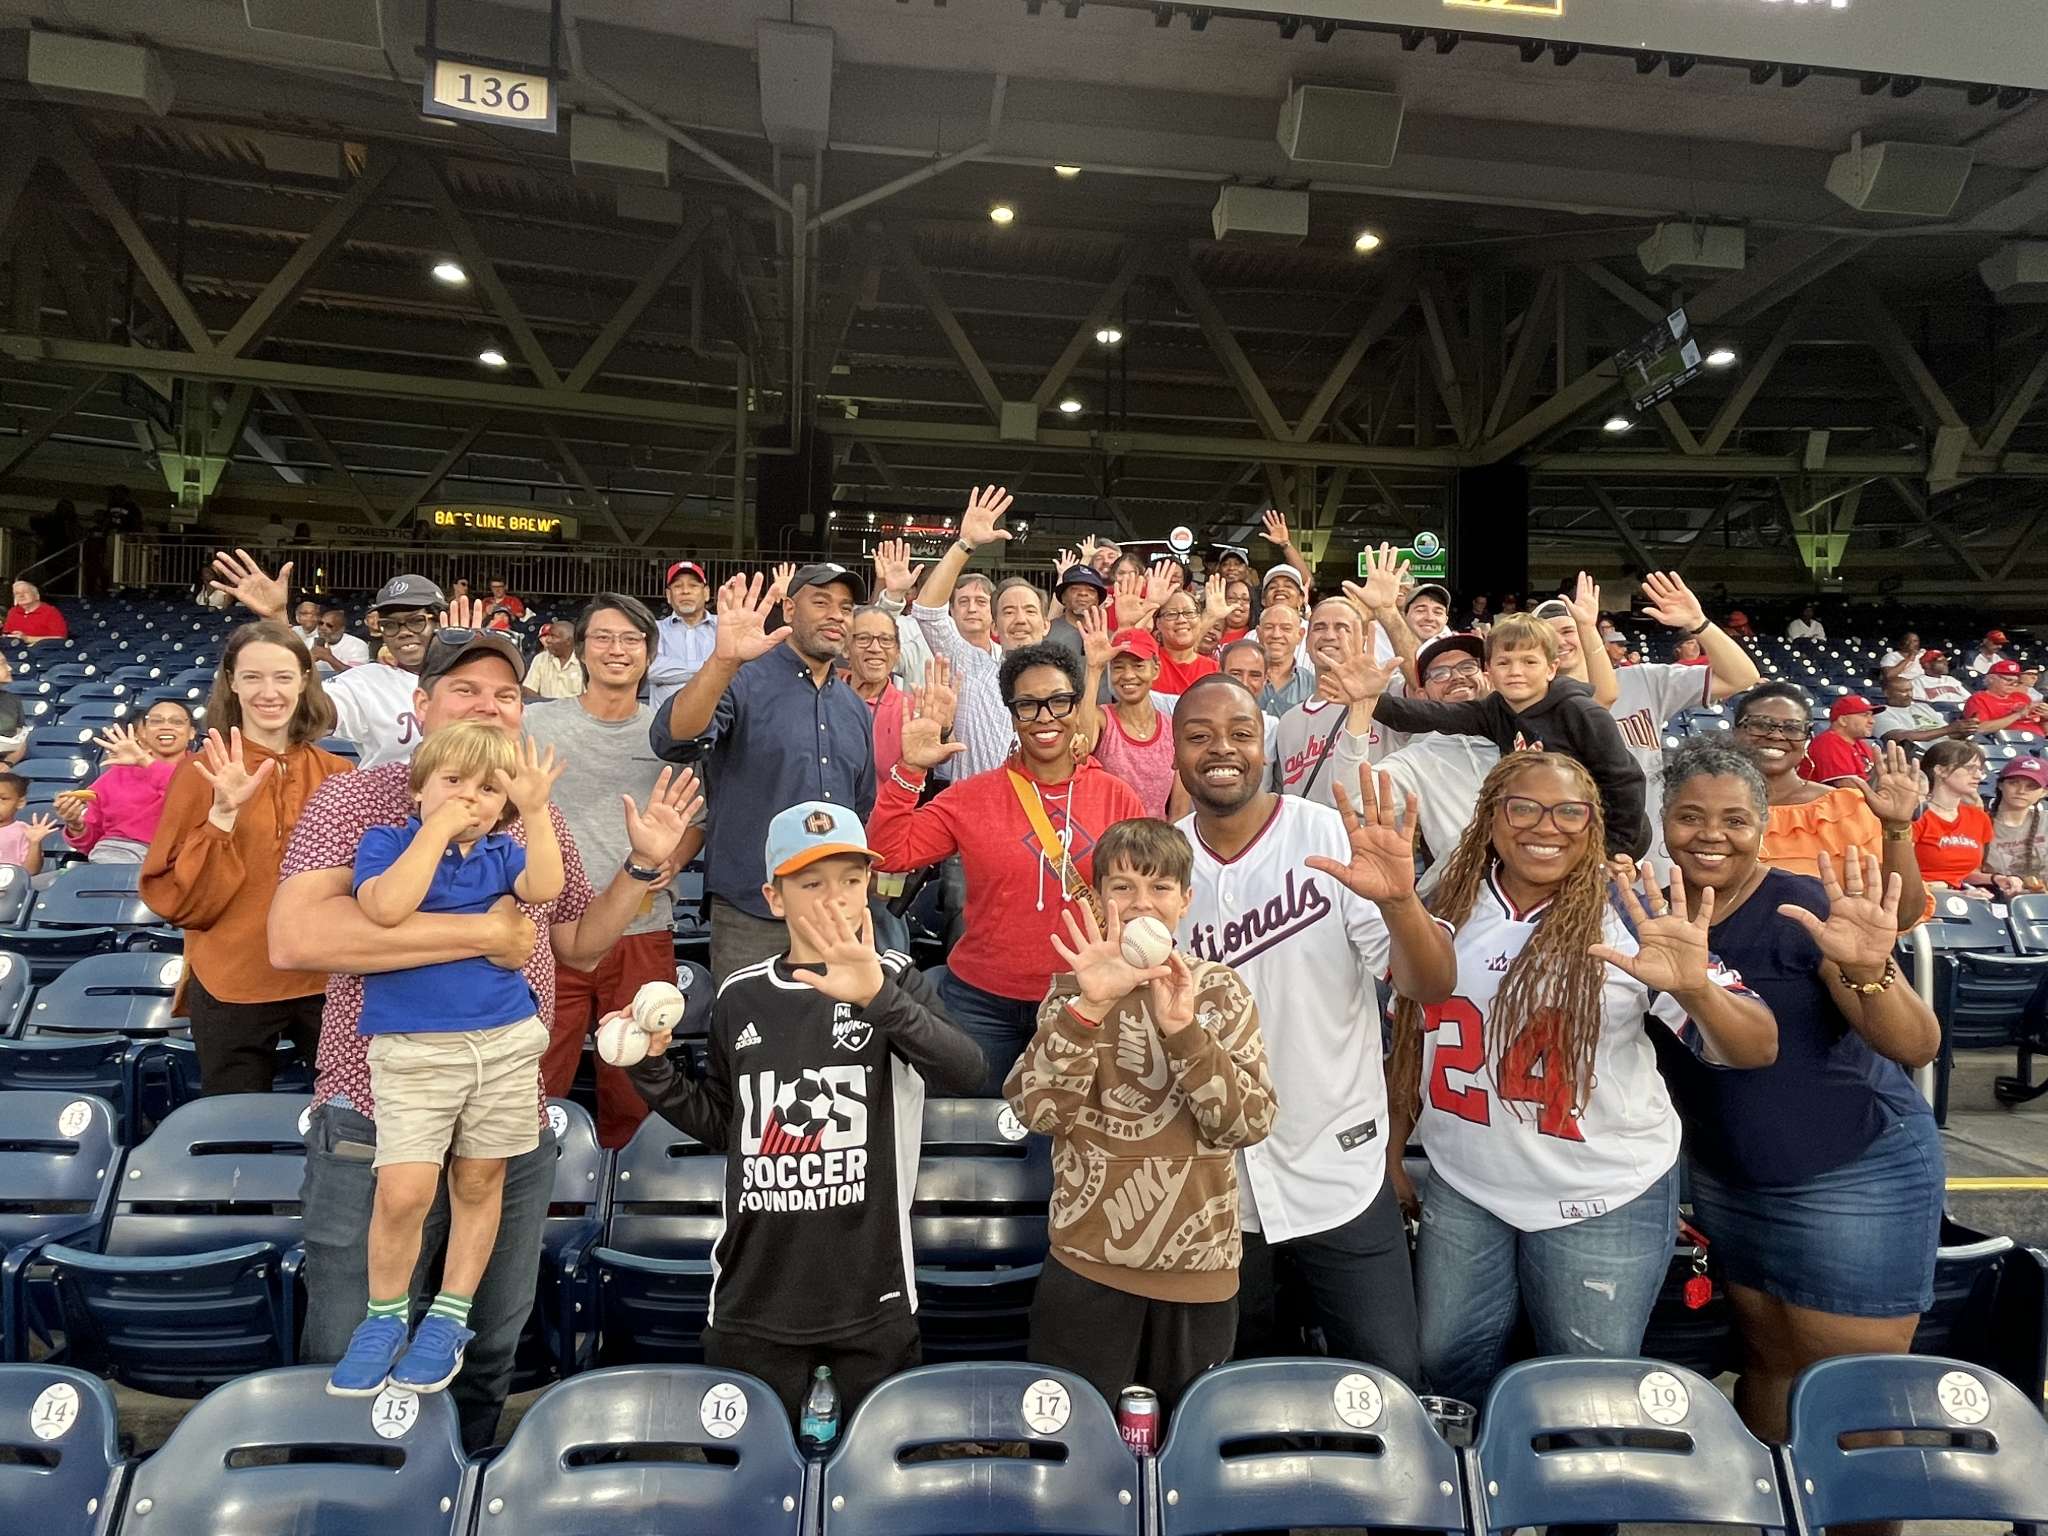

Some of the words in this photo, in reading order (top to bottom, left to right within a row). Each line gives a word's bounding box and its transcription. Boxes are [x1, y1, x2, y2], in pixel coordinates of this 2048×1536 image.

[457, 73, 530, 112] 136
[476, 513, 506, 530] LINE
[1409, 563, 1442, 572] UNTAIN
[1190, 867, 1331, 963] tionals
[1116, 1008, 1147, 1075] NIKE
[1423, 995, 1587, 1143] 24
[742, 1148, 868, 1190] SOCCER
[738, 1180, 866, 1214] FOUNDATION
[1102, 1157, 1176, 1240] NIKE
[1593, 1203, 1601, 1214] L
[1035, 1395, 1060, 1417] 17
[1346, 1390, 1371, 1410] 18
[1651, 1388, 1676, 1407] 19
[1949, 1387, 1977, 1407] 20
[41, 1400, 68, 1422] 14
[382, 1399, 410, 1421] 15
[711, 1400, 737, 1421] 16
[1121, 1425, 1150, 1444] GHT
